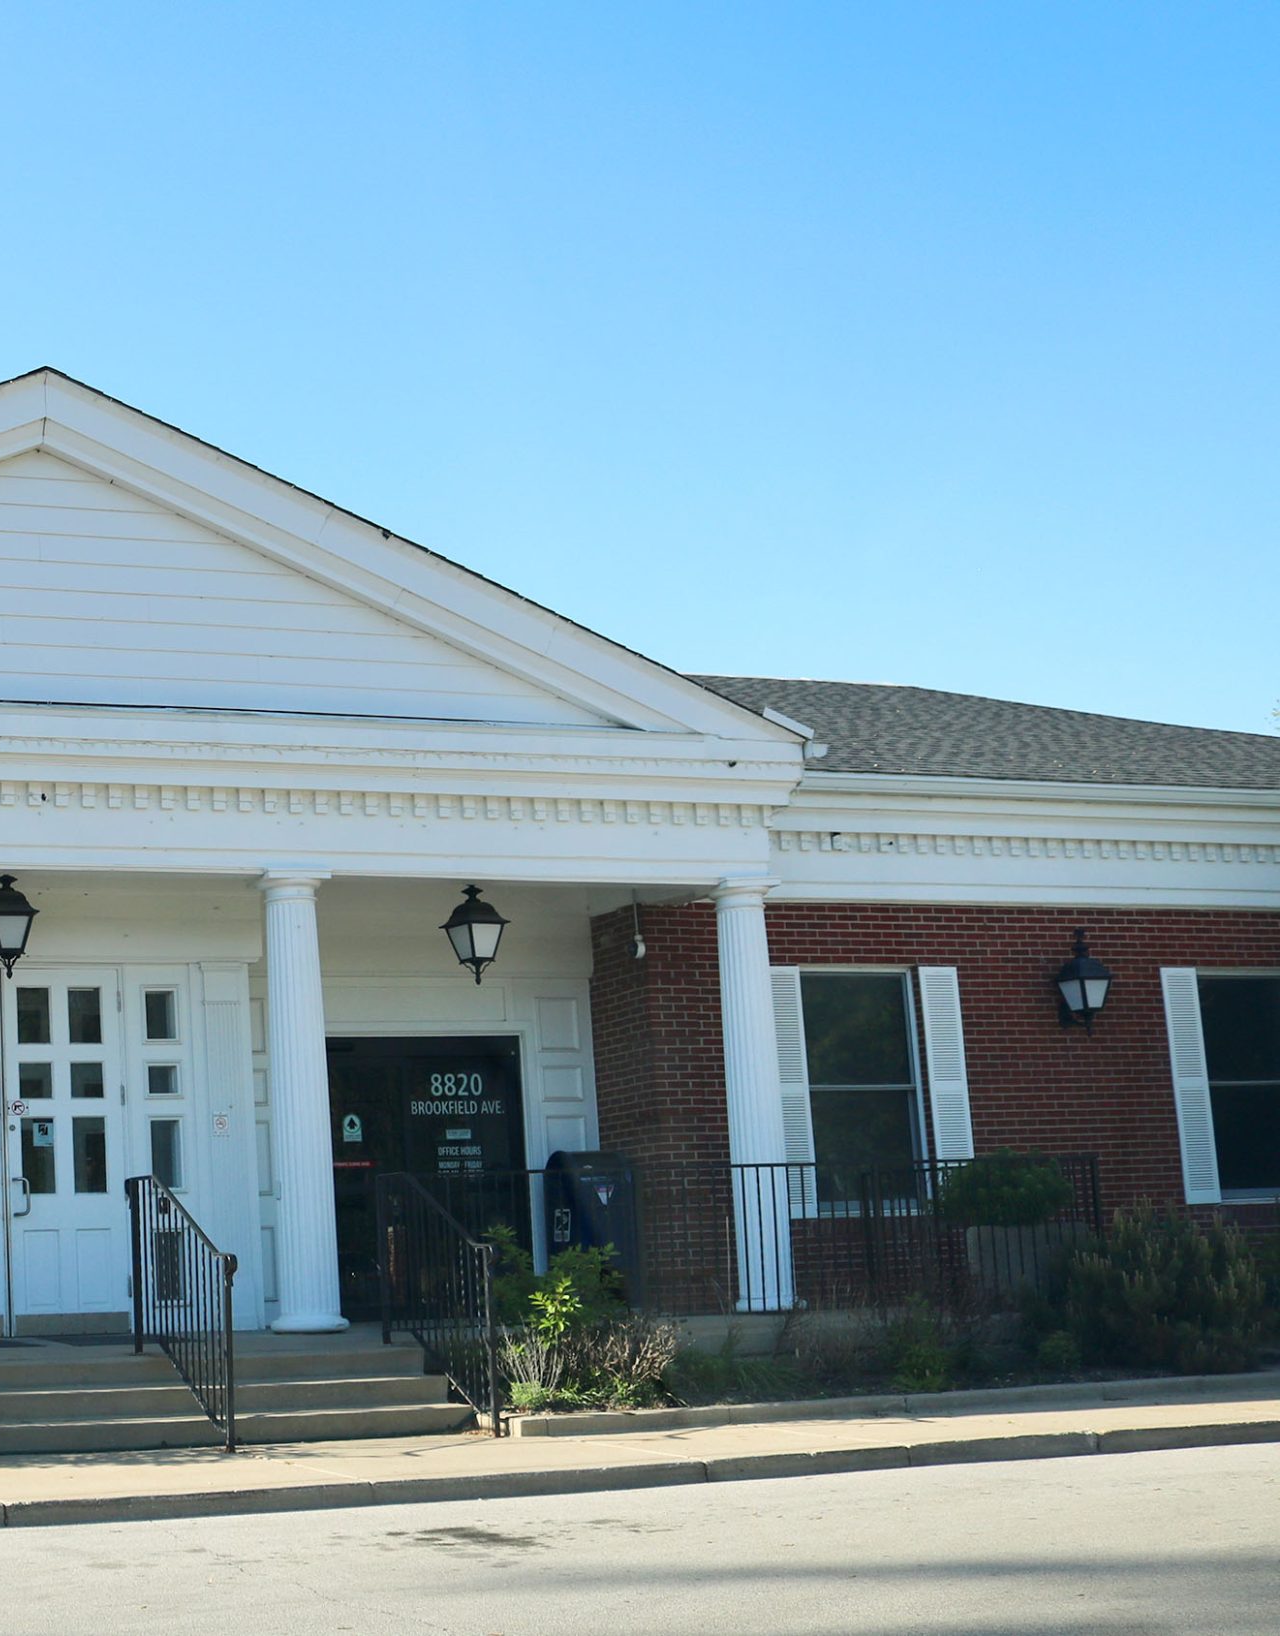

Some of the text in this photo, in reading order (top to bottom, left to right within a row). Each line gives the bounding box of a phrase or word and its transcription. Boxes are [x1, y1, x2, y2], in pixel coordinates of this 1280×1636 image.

[431, 1073, 482, 1096] 8820
[411, 1100, 505, 1114] BROOKFIELD AVE.
[438, 1146, 482, 1156] OFFICE HOURS
[464, 1160, 482, 1168] FRIDAY
